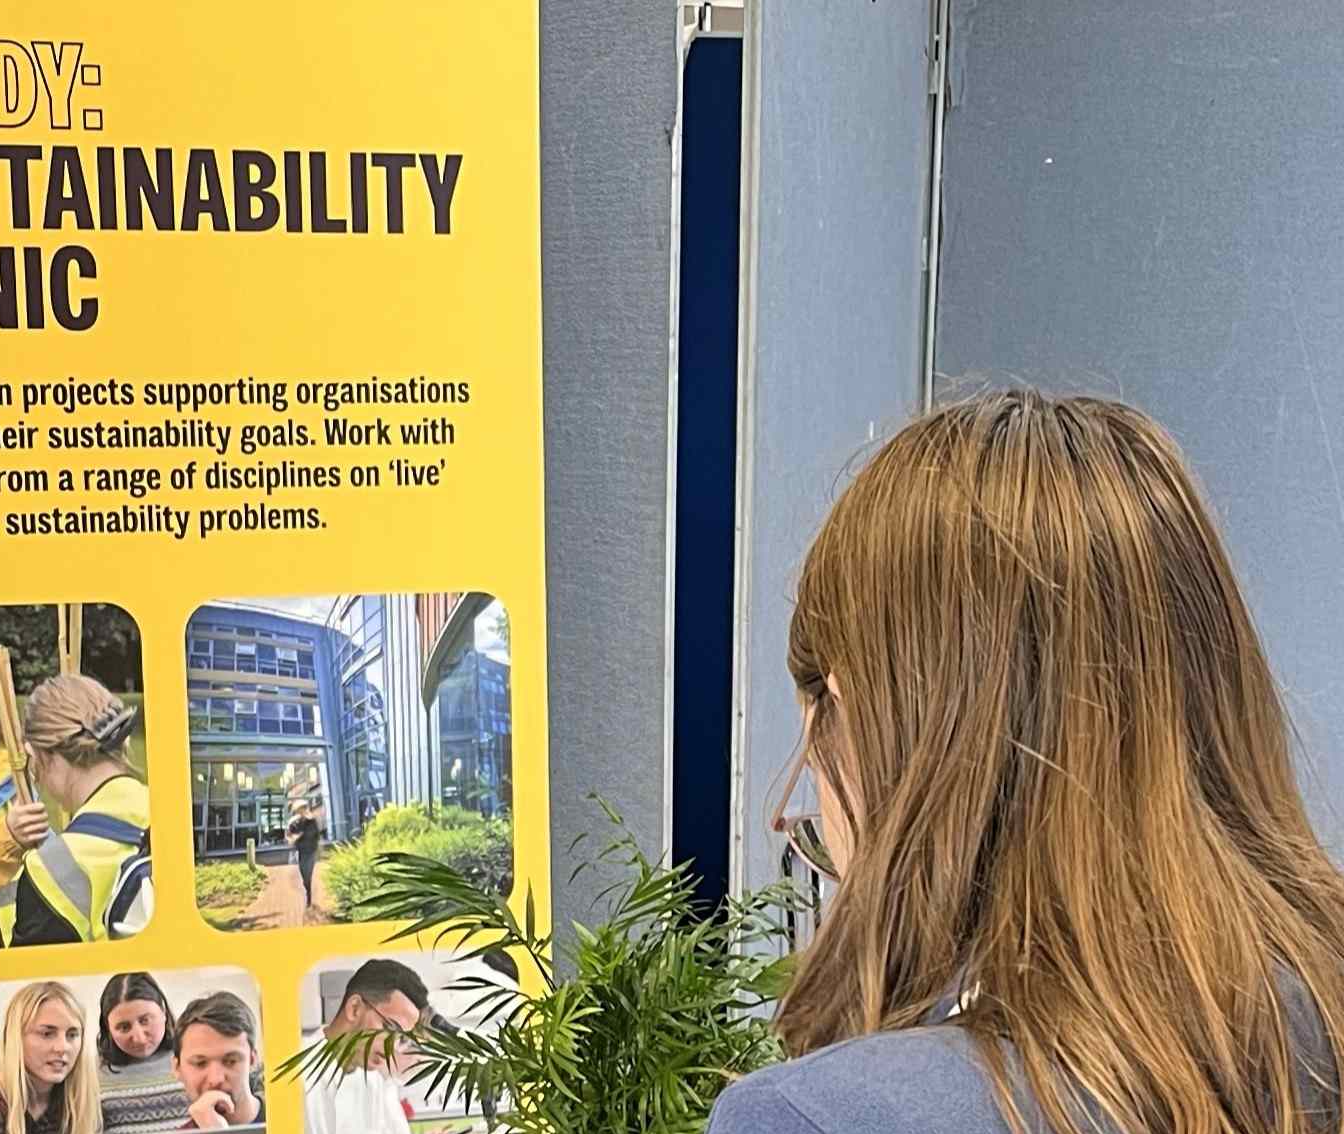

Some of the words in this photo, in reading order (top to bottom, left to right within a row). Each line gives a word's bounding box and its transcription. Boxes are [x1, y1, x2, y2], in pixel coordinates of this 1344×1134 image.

[22, 376, 135, 414] projects
[143, 376, 289, 413] supporting
[296, 375, 470, 412] organisations
[48, 419, 232, 455] sustainability
[240, 418, 316, 455] goals.
[324, 418, 392, 446] Work
[400, 417, 455, 445] with
[58, 469, 75, 492] a
[83, 468, 161, 499] range
[170, 461, 197, 490] of
[205, 460, 341, 496] disciplines
[350, 465, 380, 487] on
[5, 504, 190, 540] sustainability
[199, 502, 327, 539] problems.
